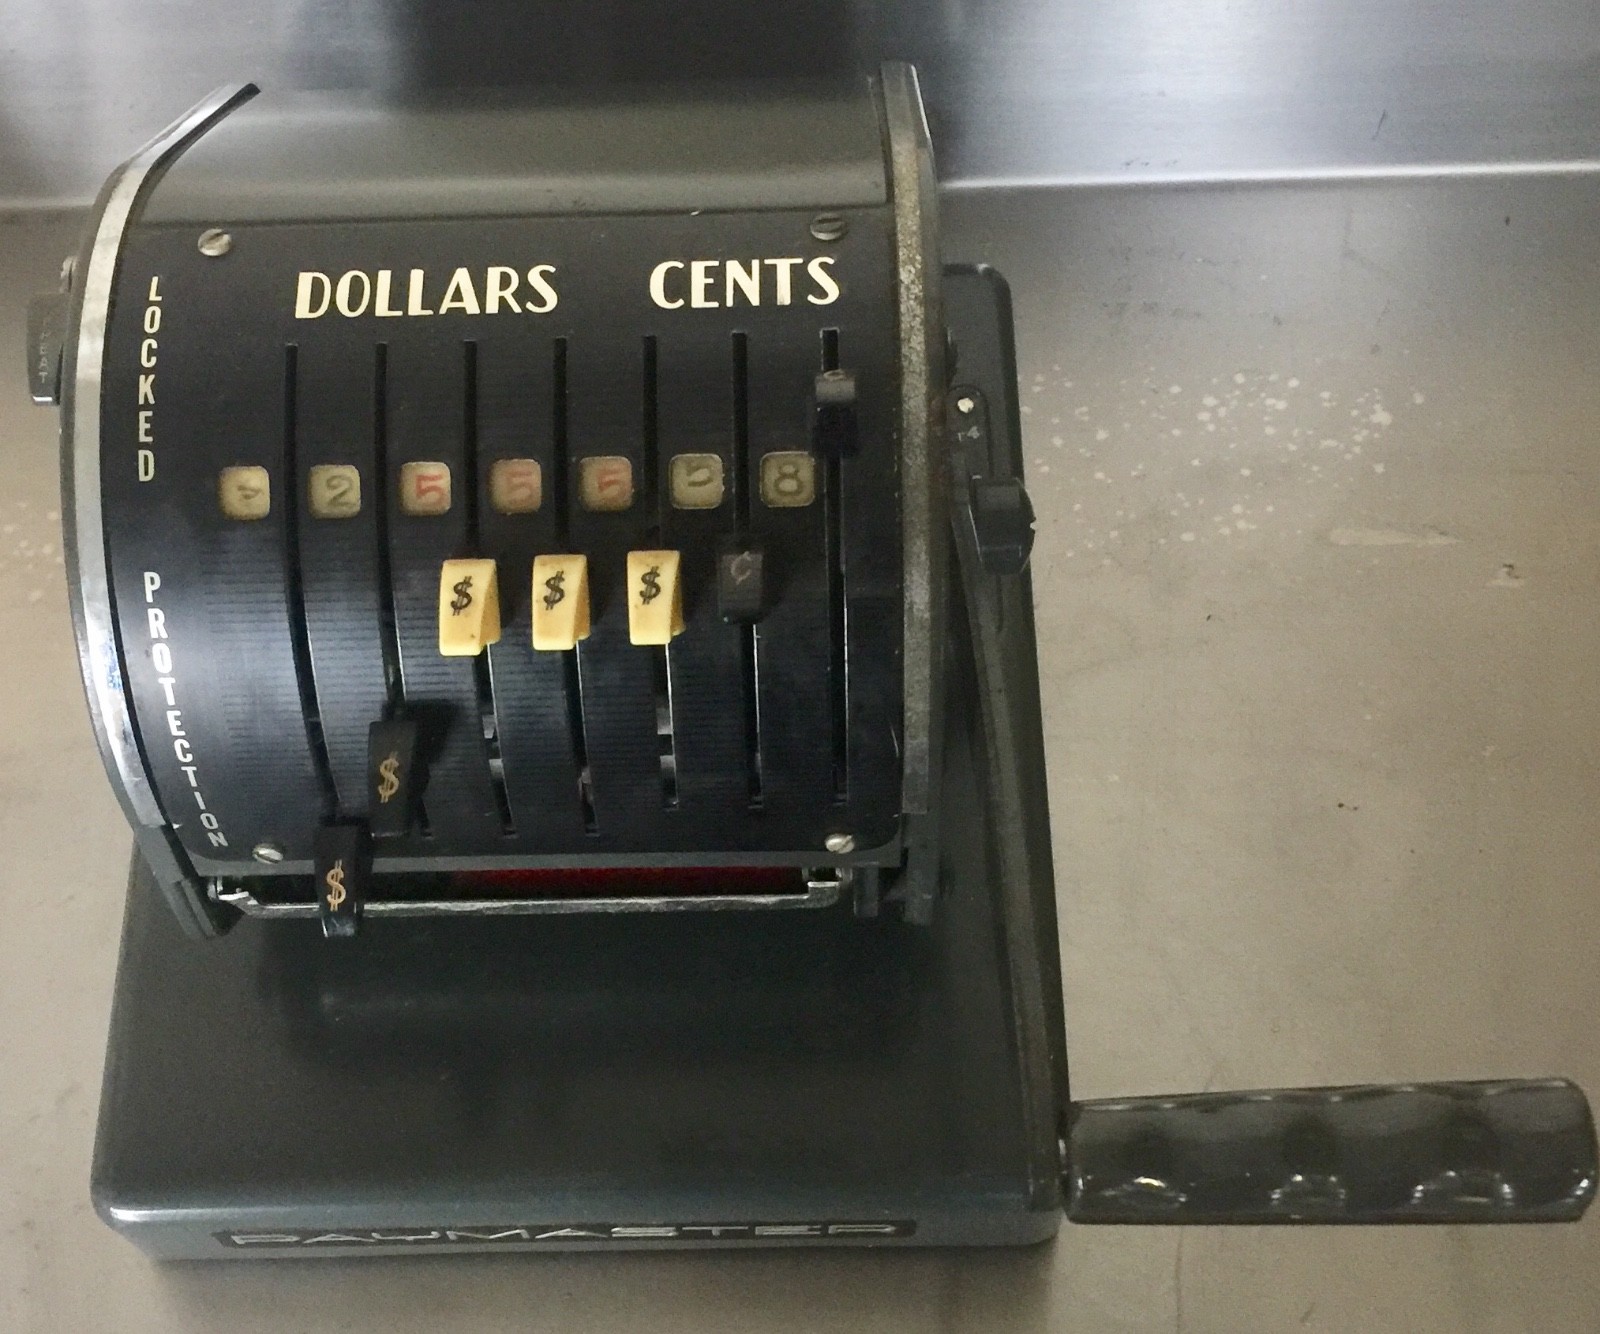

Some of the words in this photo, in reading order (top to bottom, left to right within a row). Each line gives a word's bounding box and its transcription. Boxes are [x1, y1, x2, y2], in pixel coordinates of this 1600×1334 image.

[295, 264, 559, 319] DOLLARS
[649, 257, 841, 310] CENTS
[138, 276, 162, 482] LOCKED
[325, 474, 356, 507] 2
[415, 473, 447, 506] 5
[774, 462, 805, 497] 8
[450, 575, 474, 617] $
[543, 570, 566, 611] $
[639, 566, 662, 606] $
[143, 571, 229, 848] PROTECTION
[377, 751, 400, 804] $
[325, 859, 347, 913] $
